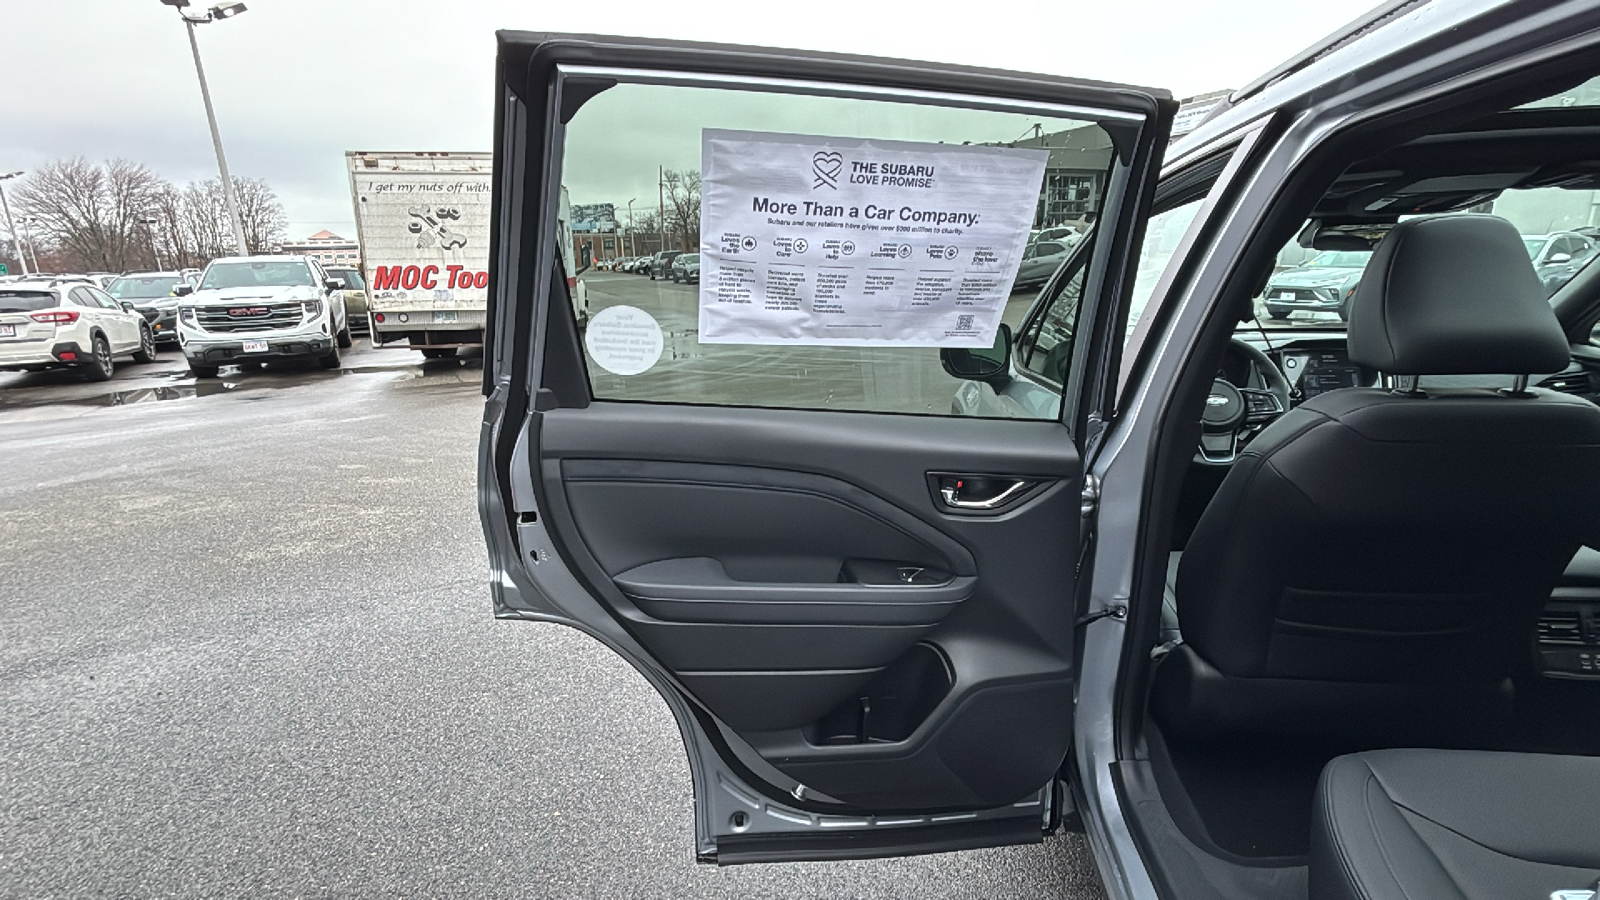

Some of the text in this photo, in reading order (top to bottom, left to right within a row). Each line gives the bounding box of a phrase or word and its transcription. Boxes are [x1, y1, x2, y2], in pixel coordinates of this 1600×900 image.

[851, 161, 934, 177] THE SUBARU
[368, 182, 373, 191] I
[375, 183, 394, 194] get
[397, 184, 415, 192] my
[418, 183, 443, 191] nuts
[446, 182, 464, 192] off
[850, 173, 933, 188] LOVE PROMISE
[752, 197, 797, 215] More
[803, 201, 844, 217] Than
[849, 207, 859, 218] a
[864, 204, 895, 220] Car
[767, 218, 790, 226] Subaru
[845, 221, 860, 229] have
[861, 223, 879, 231] given
[373, 265, 439, 290] MOC
